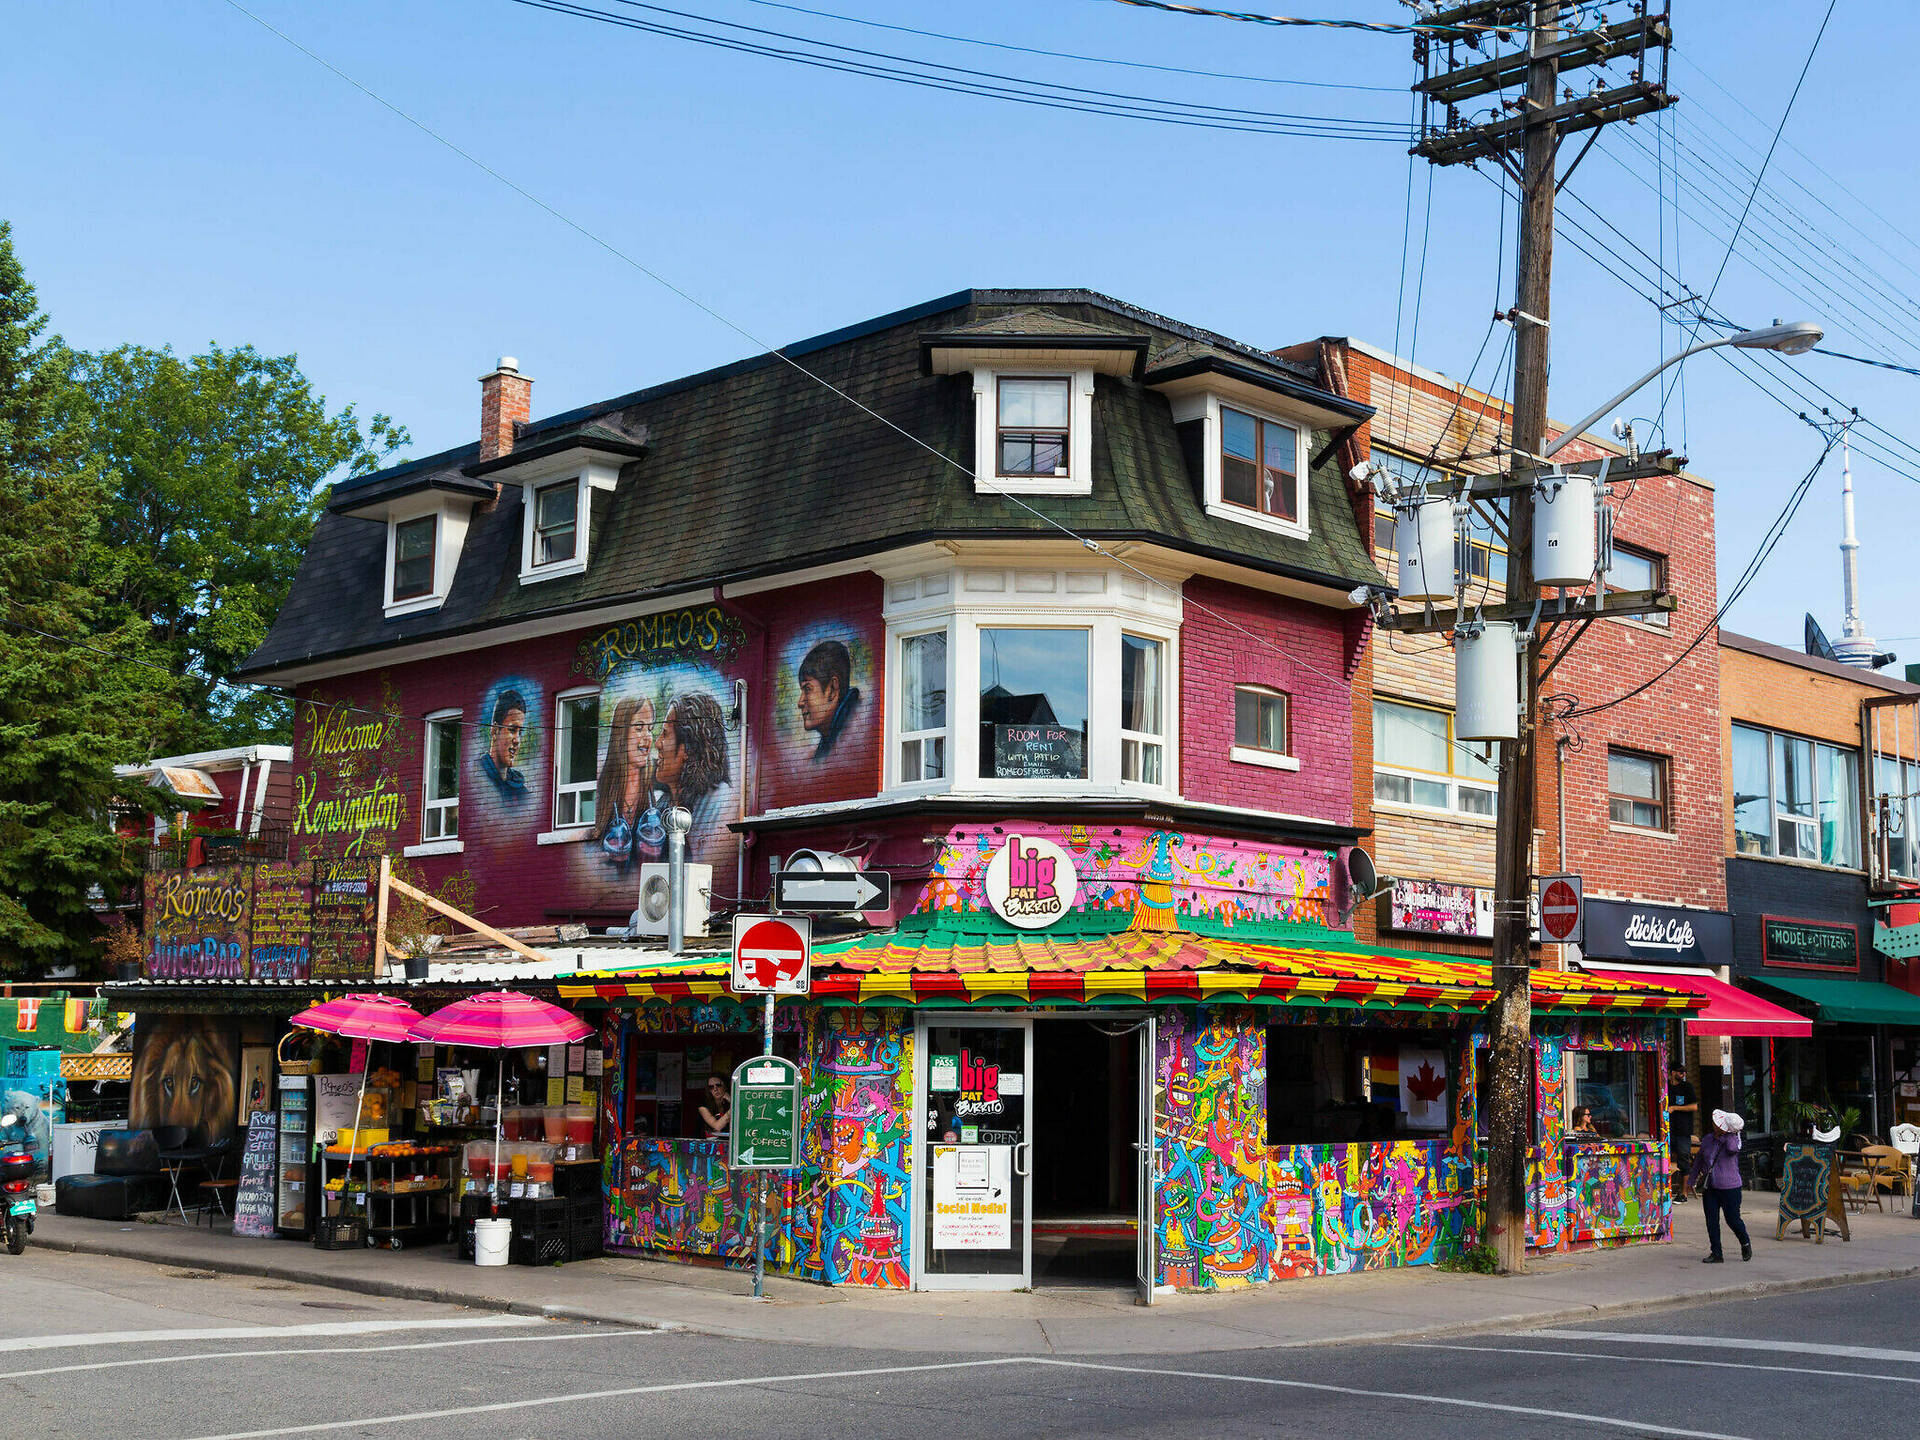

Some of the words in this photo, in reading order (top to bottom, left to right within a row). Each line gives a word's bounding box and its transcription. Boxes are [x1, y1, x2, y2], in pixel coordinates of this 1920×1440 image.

[306, 700, 391, 757] Welcome
[1008, 728, 1040, 742] ROOM
[1046, 730, 1067, 742] FOR
[1026, 742, 1053, 751] RENT
[1008, 753, 1028, 762] WITH
[1033, 752, 1060, 762] PATIO
[293, 771, 401, 858] Kensington
[1009, 837, 1057, 899] big
[160, 873, 245, 922] Romeo's
[1010, 887, 1037, 899] FAT
[1625, 914, 1666, 942] Rick's
[1775, 929, 1807, 946] MODEL
[1813, 933, 1847, 949] CITIZEN
[202, 937, 241, 978] BAR
[935, 1058, 954, 1067] PASS
[960, 1048, 1001, 1103] big
[745, 1091, 783, 1100] COFFEE
[961, 1091, 983, 1101] FAT
[746, 1103, 773, 1121] $1
[751, 1138, 787, 1147] COFFEE
[982, 1132, 1018, 1144] OPEN
[936, 1203, 969, 1215] Social
